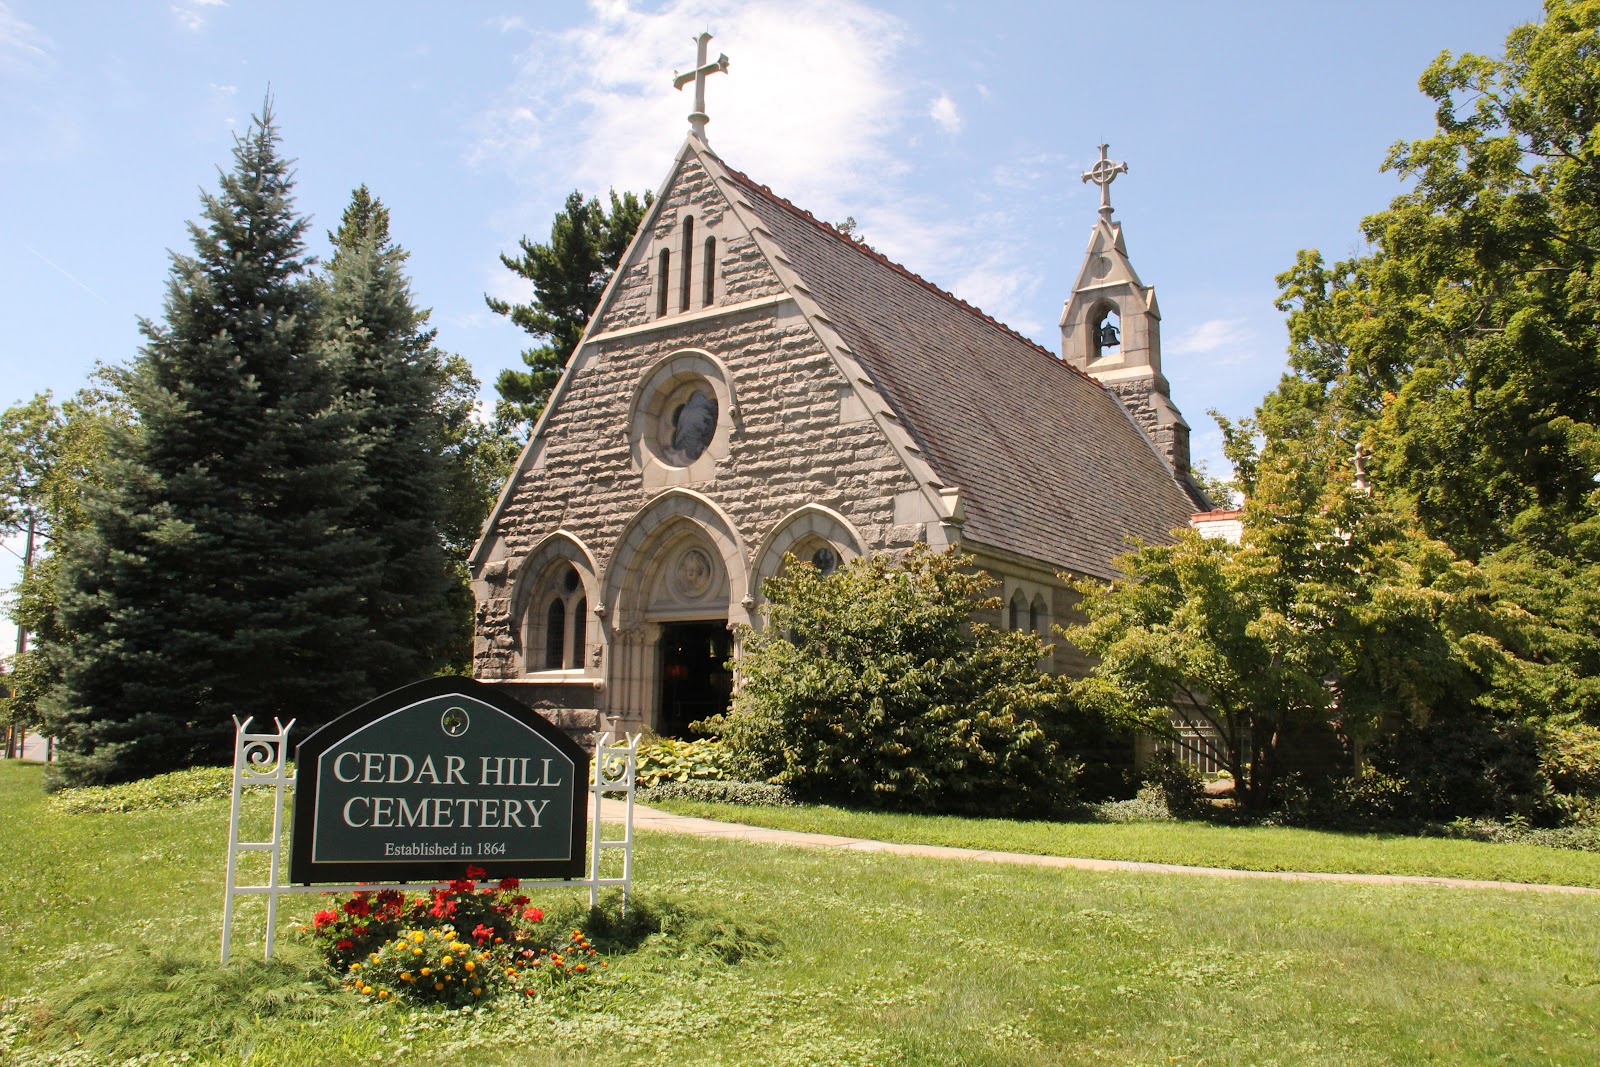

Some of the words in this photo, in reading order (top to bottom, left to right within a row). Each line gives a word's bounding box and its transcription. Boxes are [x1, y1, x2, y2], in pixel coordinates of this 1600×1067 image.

[333, 751, 469, 785] CEDAR
[478, 756, 562, 787] HILL
[342, 796, 551, 828] CEMETERY
[384, 842, 457, 856] Established
[460, 843, 472, 855] in
[476, 842, 506, 856] 1864
